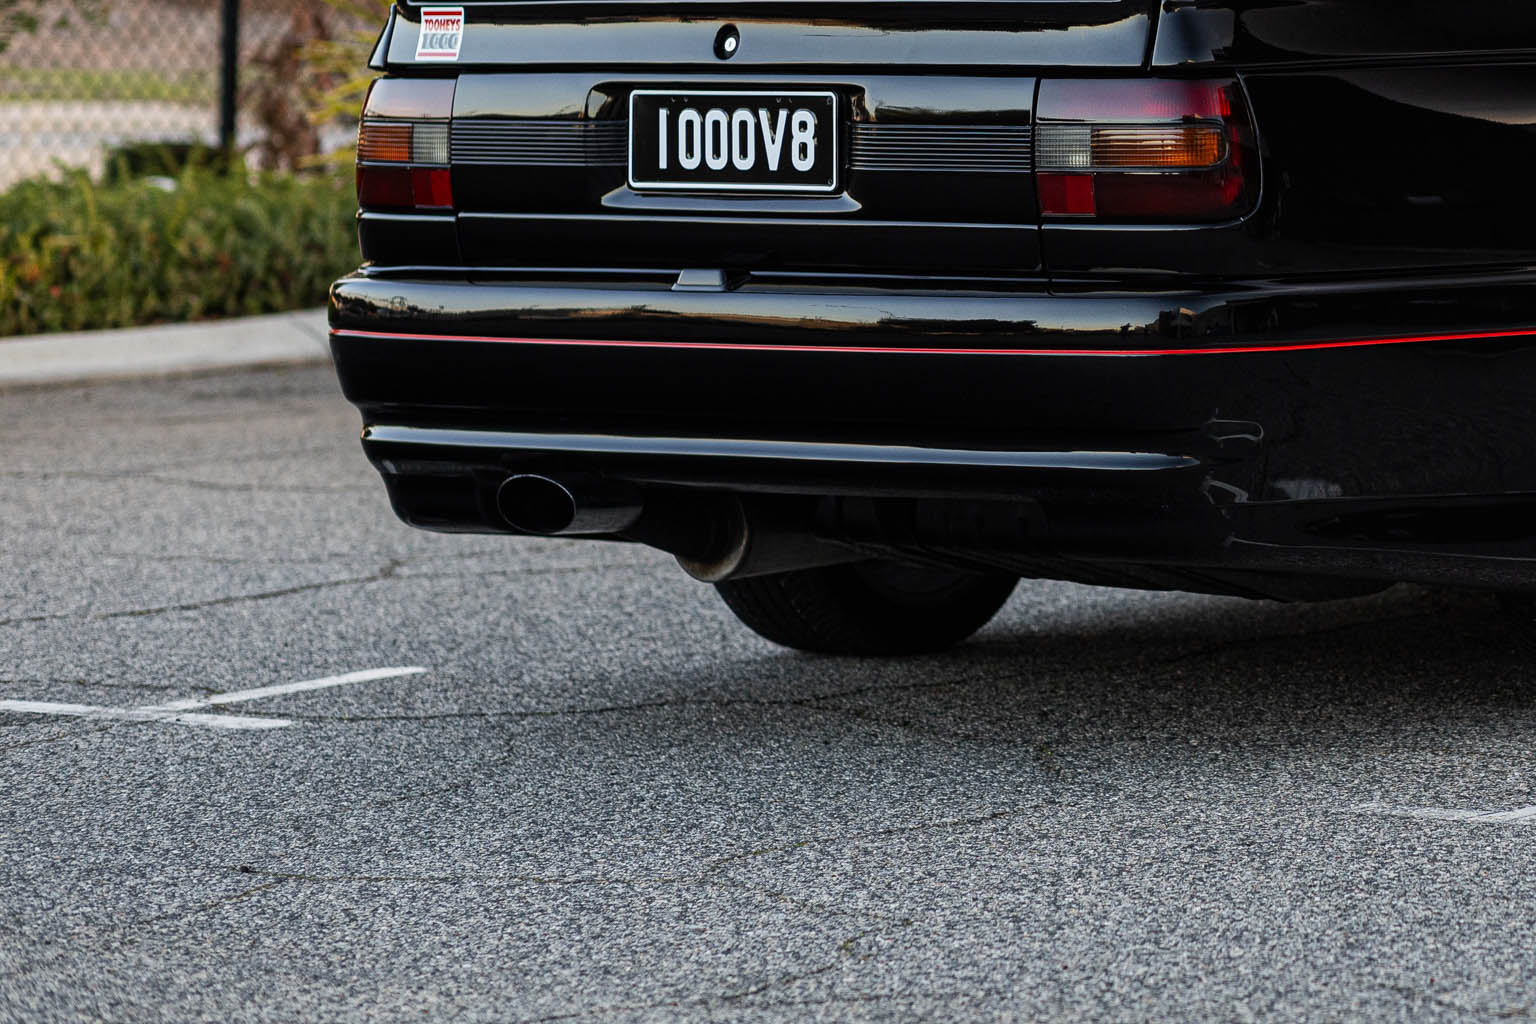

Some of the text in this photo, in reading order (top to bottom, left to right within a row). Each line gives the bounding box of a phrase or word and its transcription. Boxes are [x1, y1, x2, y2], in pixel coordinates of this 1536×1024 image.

[424, 18, 461, 32] TOOHEYS
[421, 33, 460, 50] 1000
[658, 107, 817, 172] 1000V8
